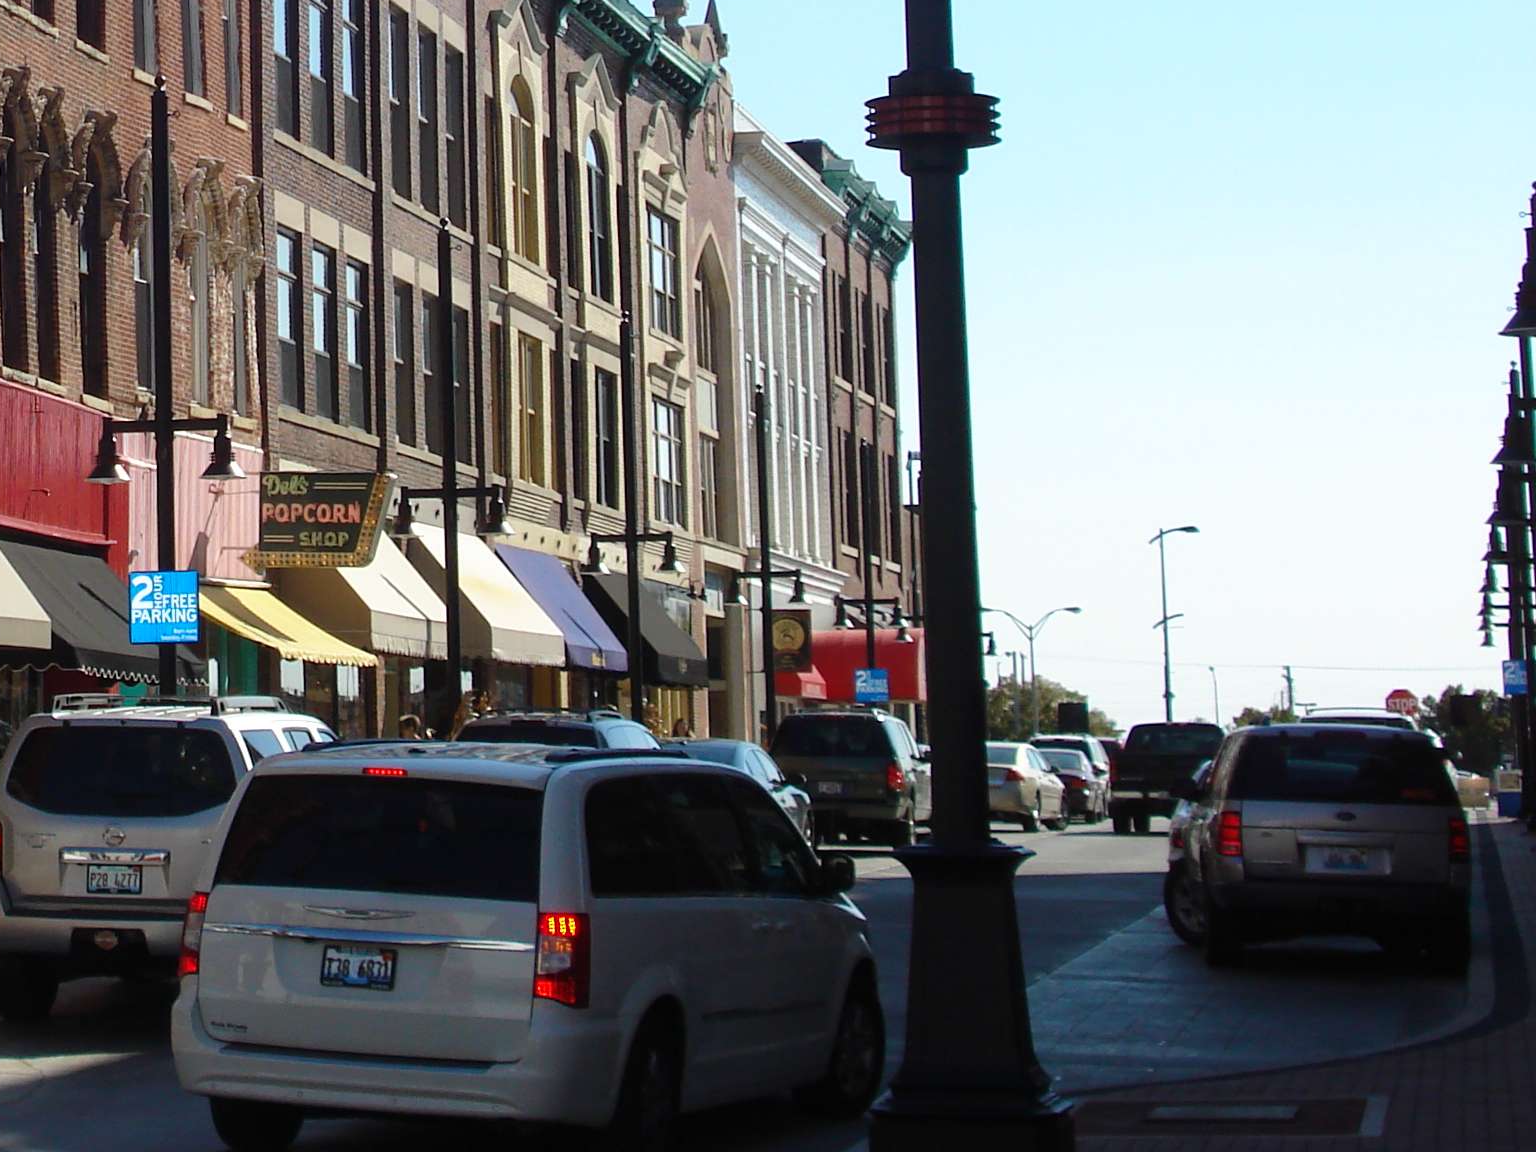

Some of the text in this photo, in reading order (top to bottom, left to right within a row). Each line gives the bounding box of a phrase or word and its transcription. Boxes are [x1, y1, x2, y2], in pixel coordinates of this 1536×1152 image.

[262, 474, 310, 496] Del's
[261, 501, 362, 524] POPCORN
[299, 531, 350, 547] SHOP
[131, 575, 163, 609] 2 HOUR
[162, 593, 198, 609] FREE
[131, 608, 198, 624] PARKING
[855, 669, 867, 686] 2
[1387, 698, 1416, 711] STOP
